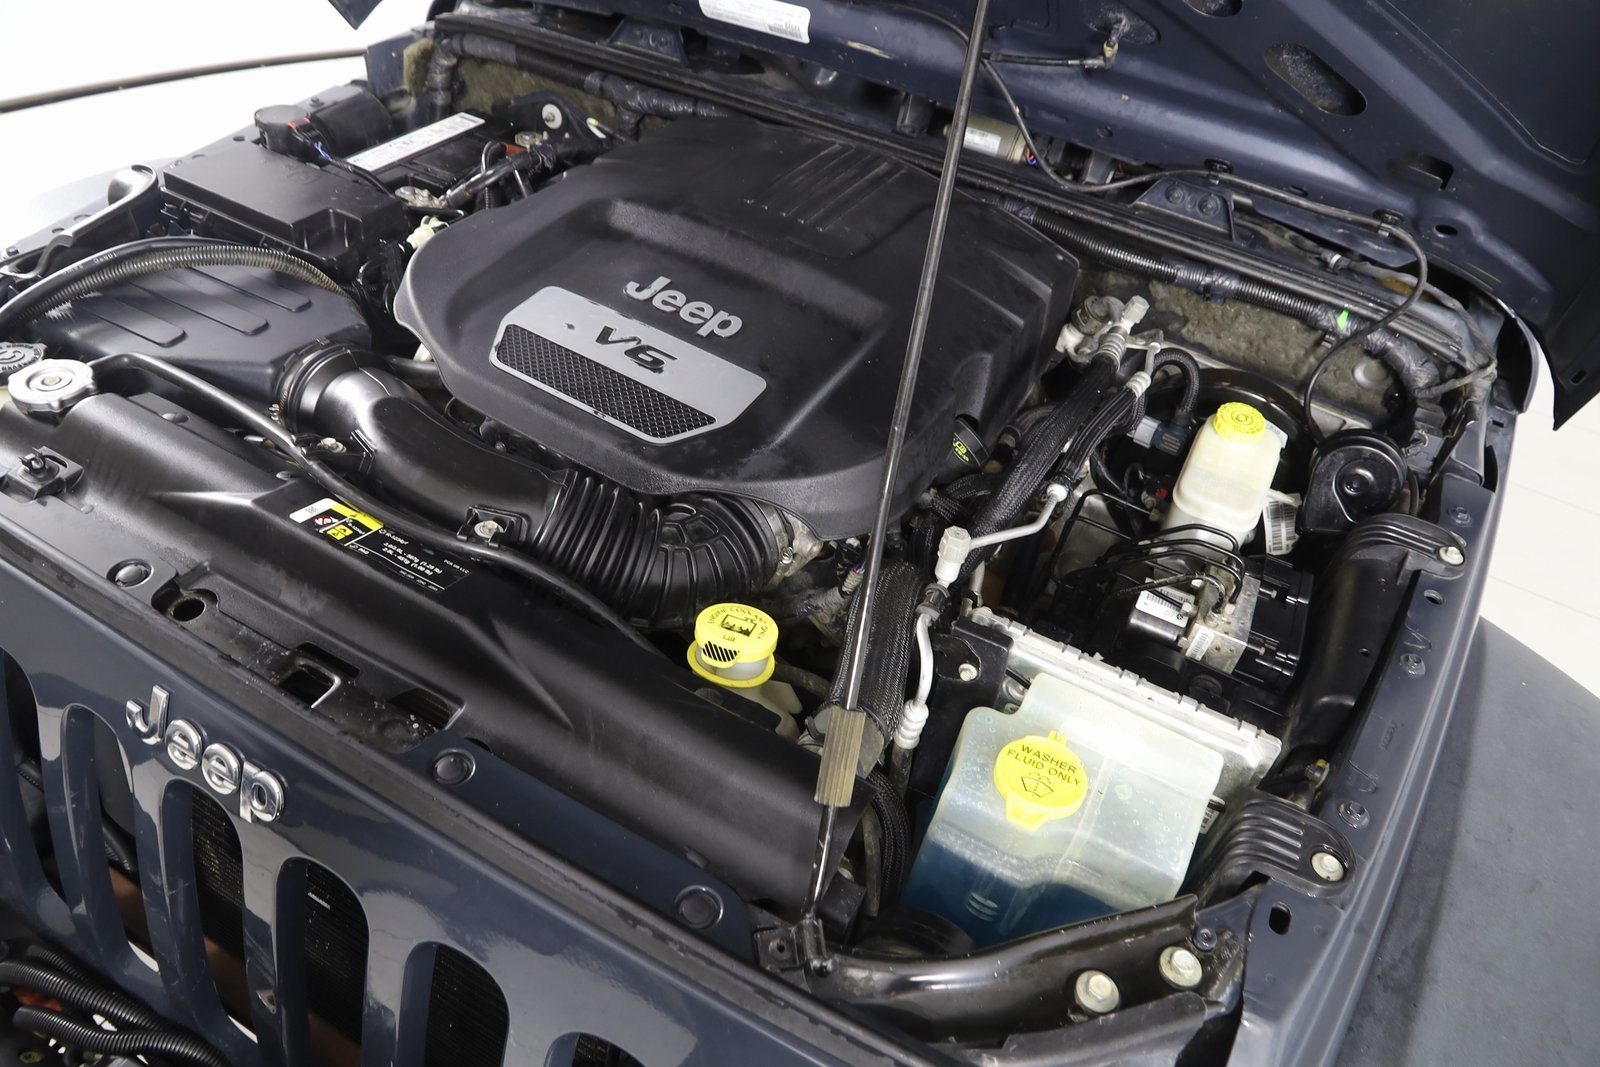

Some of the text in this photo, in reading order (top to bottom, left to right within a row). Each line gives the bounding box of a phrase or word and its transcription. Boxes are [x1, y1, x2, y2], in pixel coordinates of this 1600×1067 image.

[622, 275, 743, 338] Jeep
[595, 325, 678, 374] V6
[125, 684, 285, 823] Jeep
[1007, 749, 1081, 787] FLUID ONLY
[1021, 744, 1077, 774] WASHER
